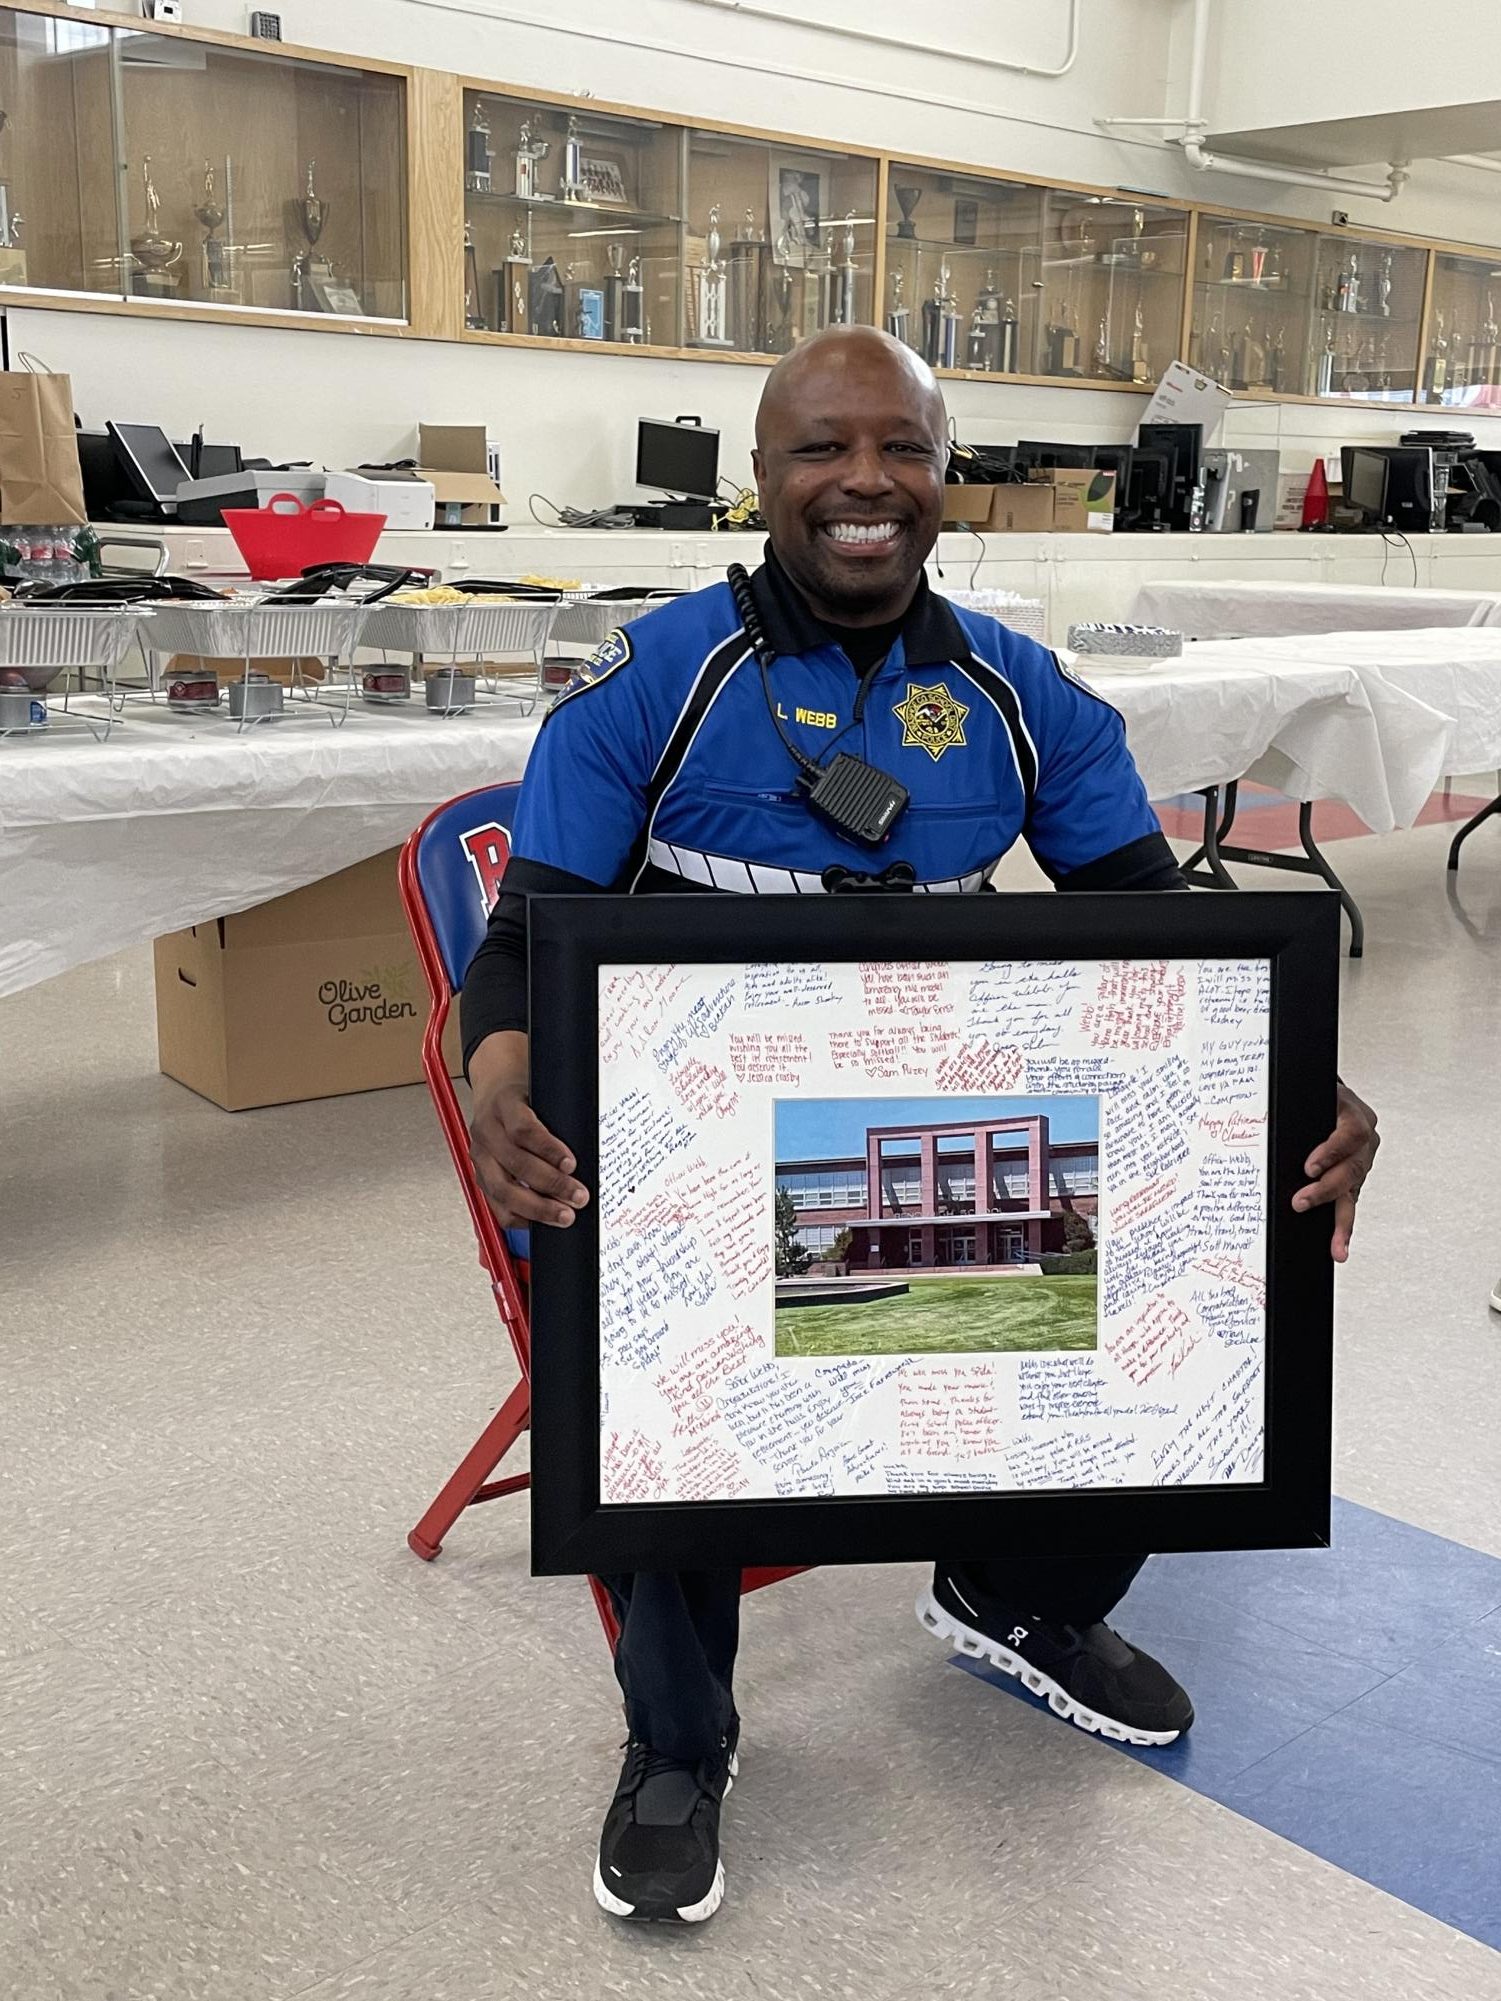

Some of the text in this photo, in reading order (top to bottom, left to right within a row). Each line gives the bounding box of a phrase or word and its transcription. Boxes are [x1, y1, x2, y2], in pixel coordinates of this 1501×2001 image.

[777, 702, 837, 728] L WEBB
[318, 980, 382, 1005] Olive
[921, 983, 943, 992] model
[328, 999, 417, 1032] Garden
[857, 1030, 870, 1040] you
[888, 1027, 915, 1037] always
[920, 1022, 942, 1032] being
[729, 1033, 743, 1044] You
[746, 1033, 761, 1042] will
[765, 1035, 773, 1043] be
[829, 1041, 849, 1049] there
[898, 1037, 909, 1045] all
[782, 1045, 791, 1053] all
[931, 1044, 947, 1053] will
[1219, 1039, 1242, 1050] GUY
[730, 1054, 746, 1062] best
[732, 1063, 745, 1072] You
[747, 1063, 775, 1072] deserve
[834, 1061, 844, 1069] be
[877, 1065, 899, 1078] Sam
[747, 1074, 773, 1083] Jessica
[1197, 1190, 1216, 1198] Thank
[1227, 1201, 1261, 1212] difference
[1178, 1419, 1193, 1439] THE
[1195, 1391, 1216, 1419] NEXT
